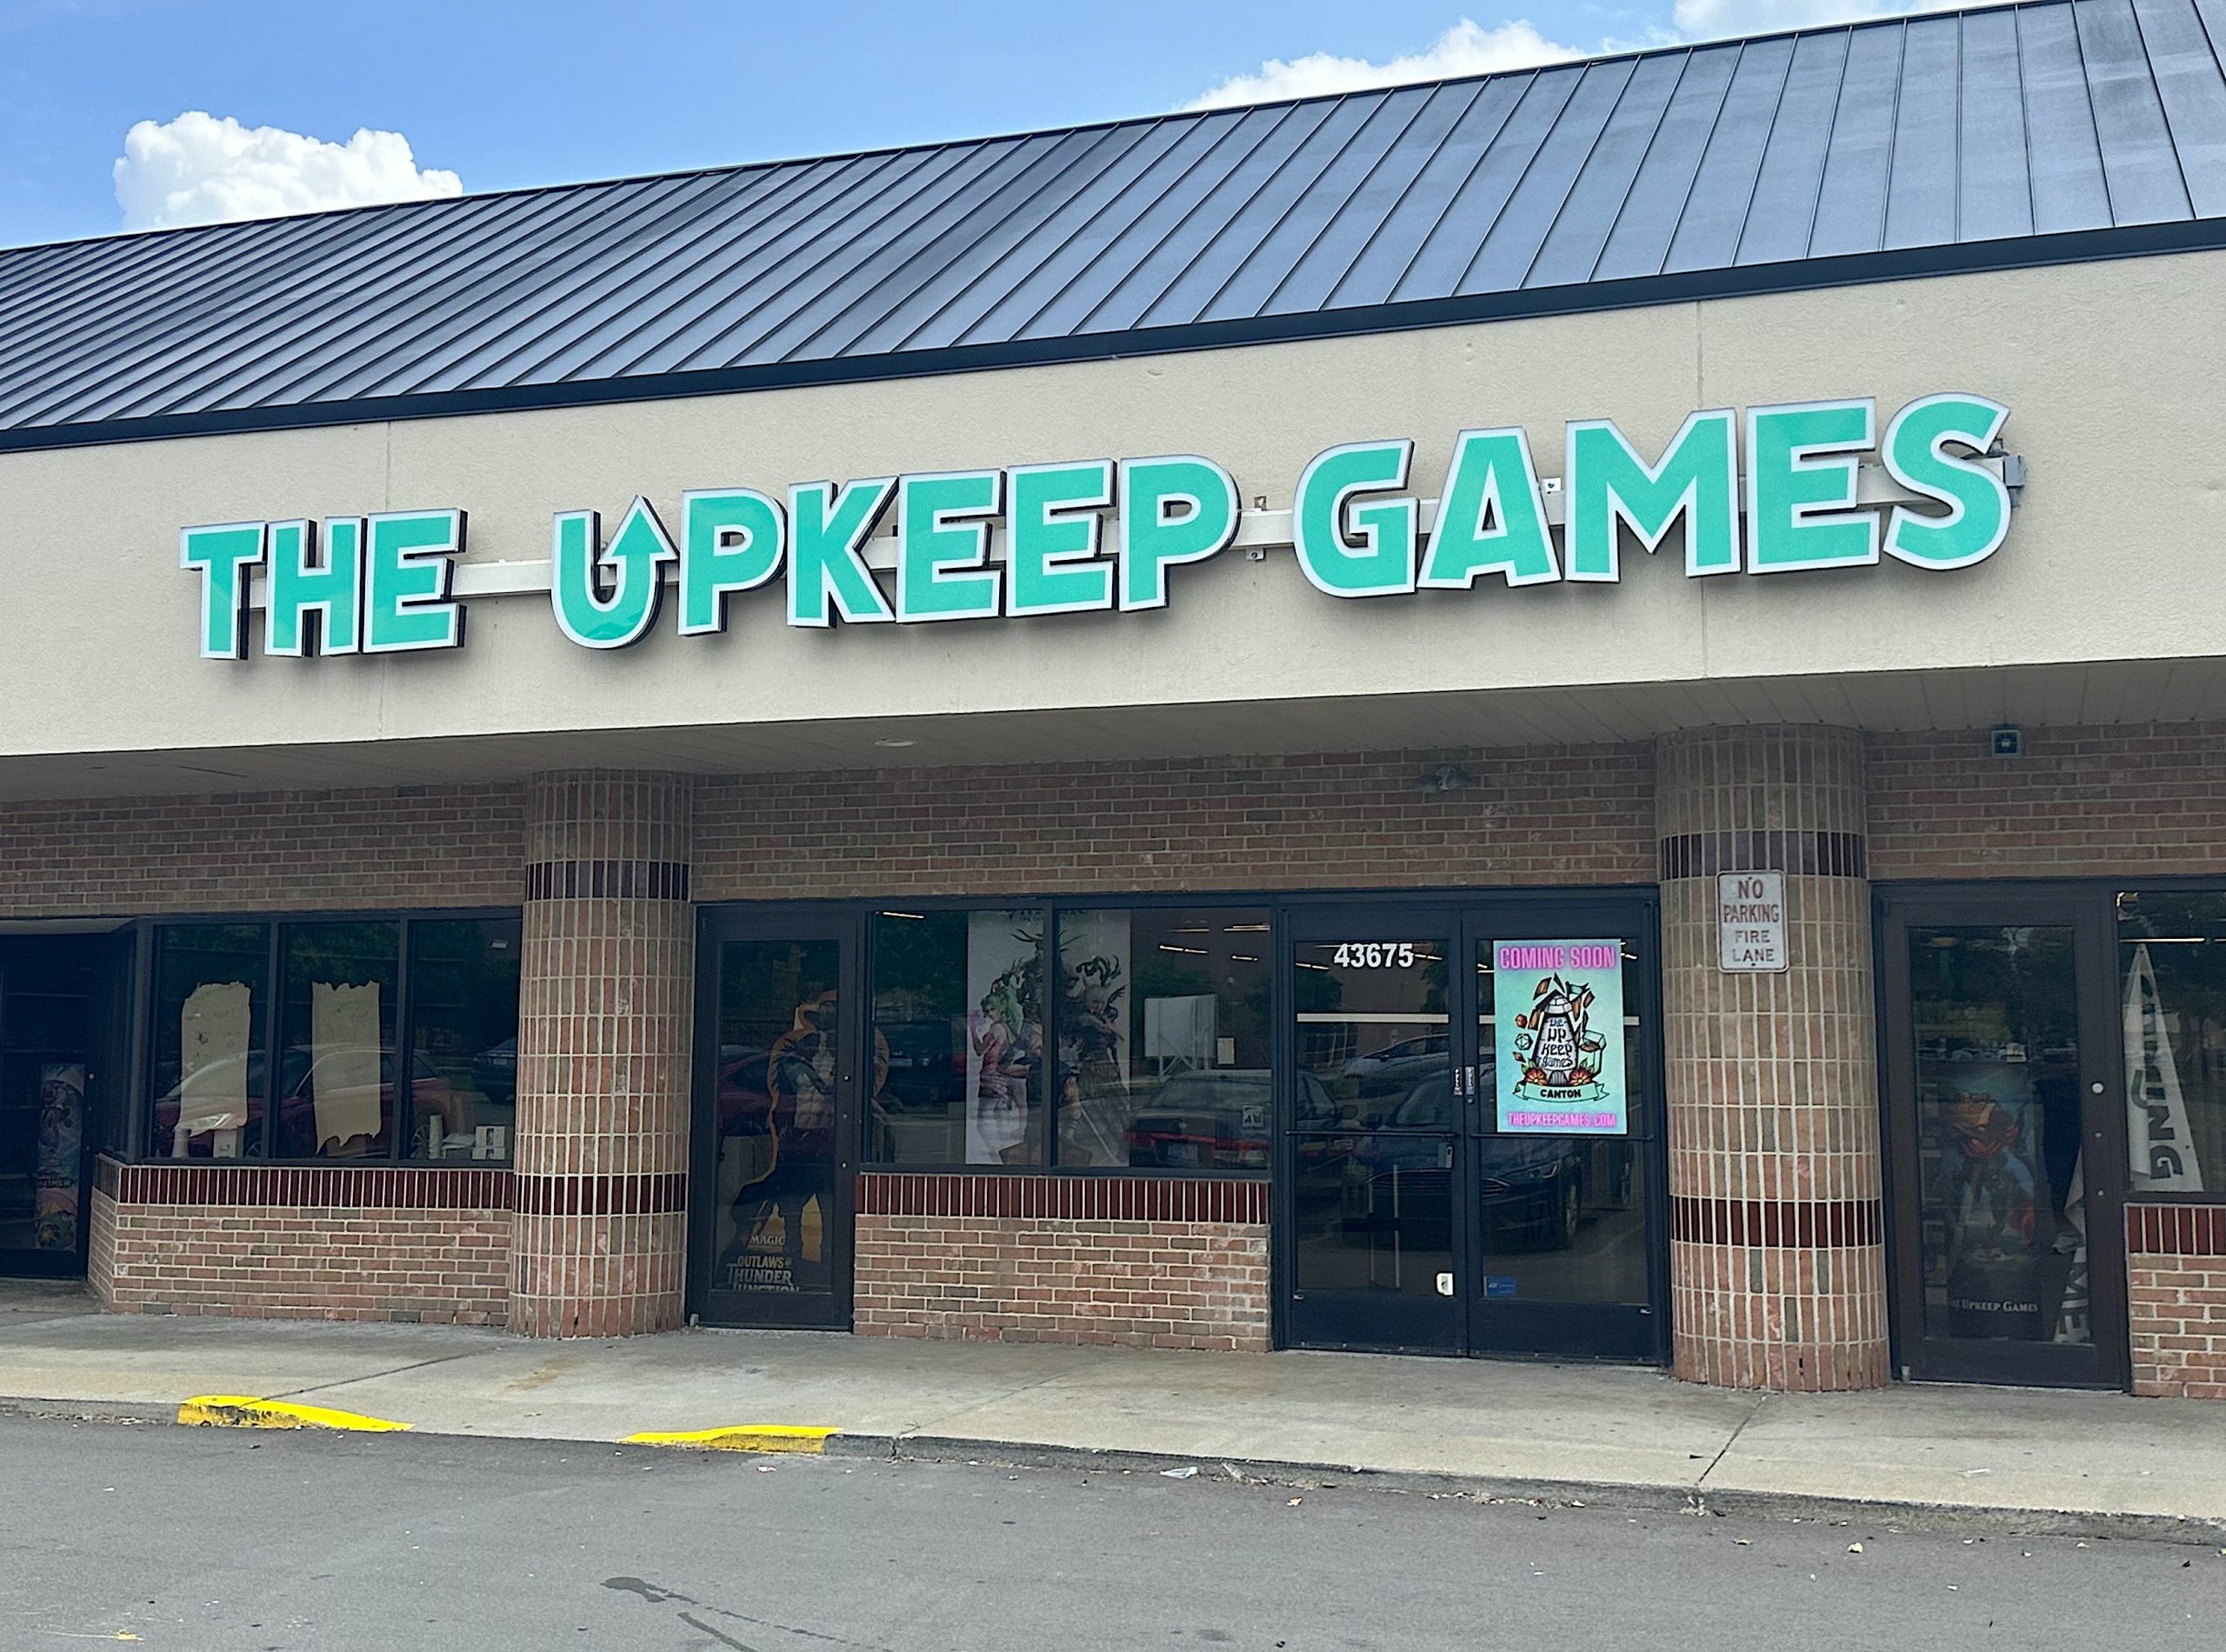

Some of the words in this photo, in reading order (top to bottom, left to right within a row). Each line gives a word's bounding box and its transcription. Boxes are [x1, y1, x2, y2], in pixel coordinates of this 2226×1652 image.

[180, 508, 465, 660] THE
[550, 454, 1240, 650] UPKEEP
[1292, 391, 2011, 599] GAMES
[1737, 880, 1763, 899] NO
[1723, 904, 1780, 923] PARKING
[1735, 929, 1770, 943] FIRE
[1333, 943, 1415, 968] 43675
[1500, 947, 1564, 969] COMING
[1570, 946, 1616, 968] SOON
[1732, 949, 1775, 963] LANE
[1540, 1089, 1582, 1099] CANTON
[1508, 1112, 1616, 1127] THEUPKEEPGAMES.COM
[737, 1255, 784, 1269] OUTLAWS
[726, 1262, 793, 1286] THUNDER
